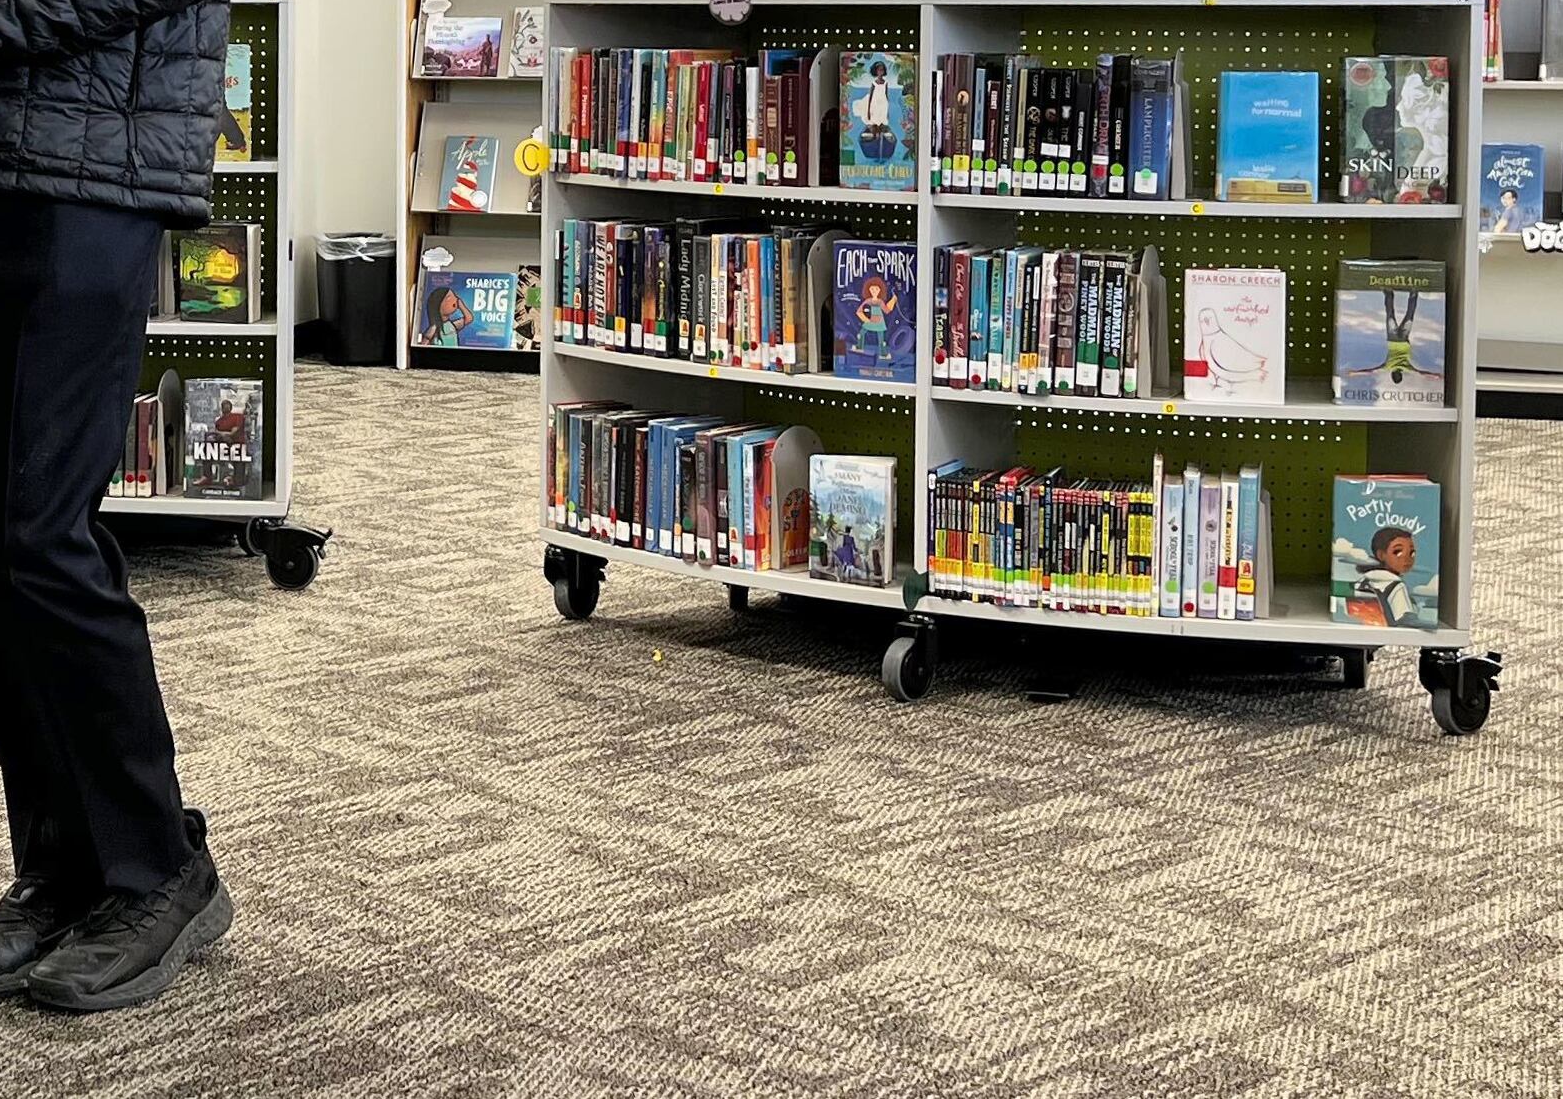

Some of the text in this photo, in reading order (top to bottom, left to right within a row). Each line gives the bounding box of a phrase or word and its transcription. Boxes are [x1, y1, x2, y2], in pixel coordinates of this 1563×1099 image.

[1142, 97, 1153, 167] LAMPLIGHTER
[450, 138, 489, 171] Apple
[521, 143, 541, 173] C
[1348, 158, 1394, 174] SKIN
[1397, 166, 1440, 180] DEEP
[679, 239, 691, 272] Lady
[837, 248, 915, 293] EACH SPARK
[1191, 274, 1281, 286] SHARON CREECH
[1369, 275, 1429, 287] Deadline
[466, 277, 510, 289] SHARICE'S
[473, 288, 509, 312] BIG
[697, 273, 706, 323] Clockwork
[1080, 280, 1088, 311] PINEY
[480, 312, 506, 323] VOICE
[1103, 281, 1114, 353] PINEY WOODS
[1111, 287, 1123, 348] MADMAN
[1344, 389, 1444, 402] CHRIS CRUTCHER
[193, 442, 252, 462] KNEEL
[1346, 498, 1394, 522] Partly
[1375, 512, 1427, 536] Cloudy
